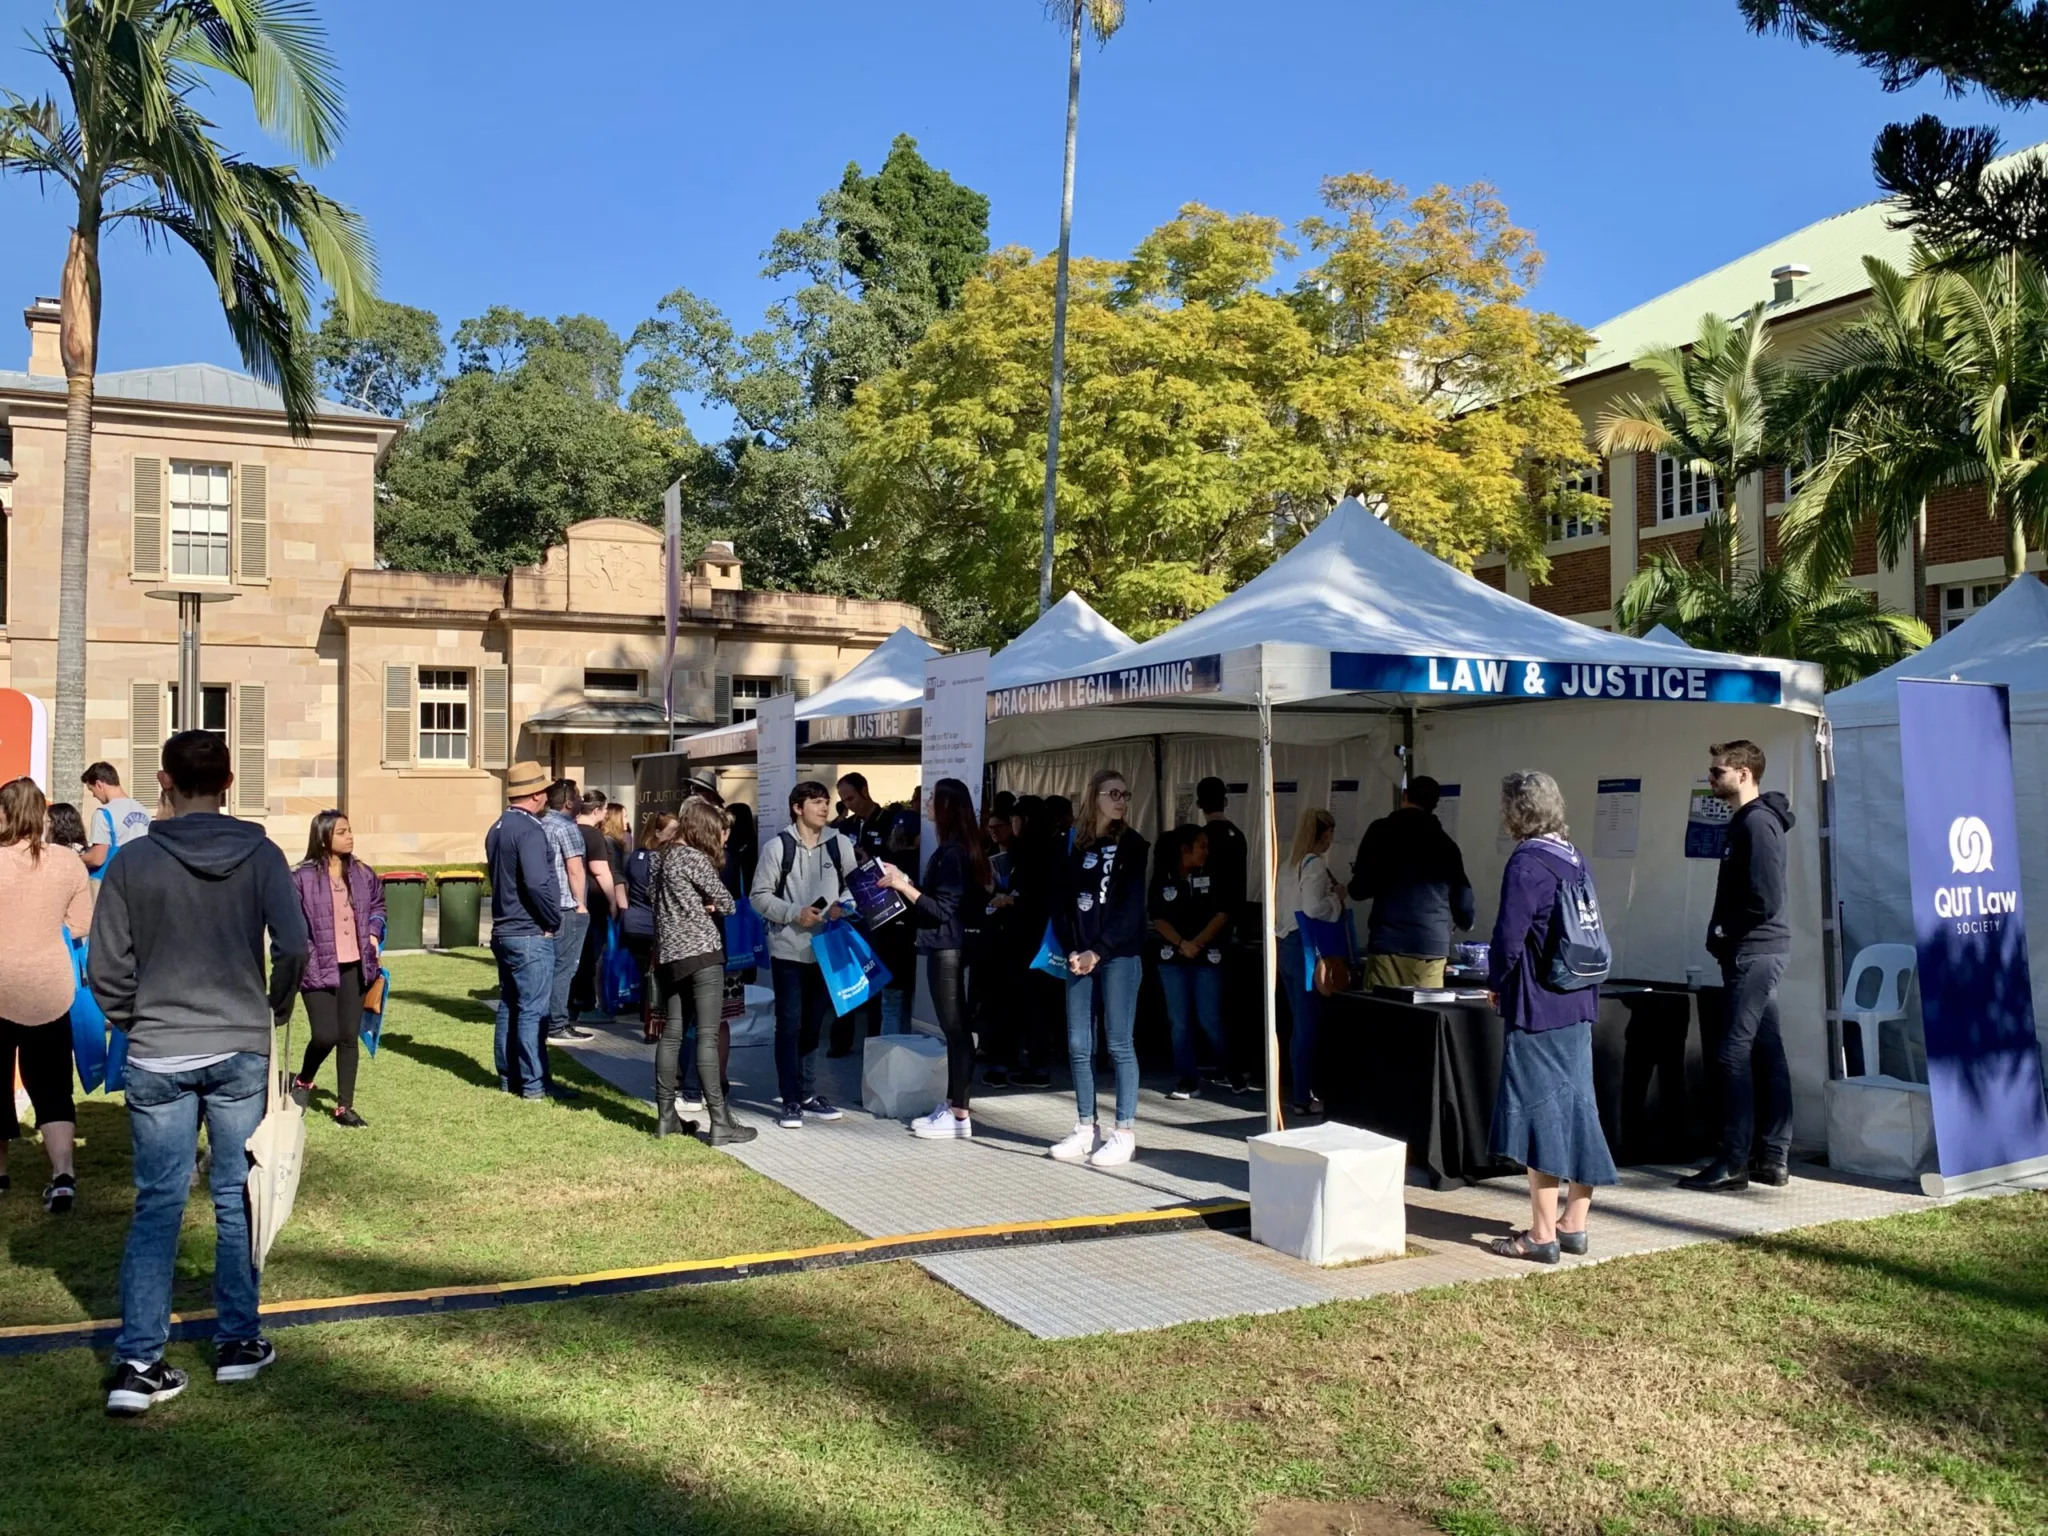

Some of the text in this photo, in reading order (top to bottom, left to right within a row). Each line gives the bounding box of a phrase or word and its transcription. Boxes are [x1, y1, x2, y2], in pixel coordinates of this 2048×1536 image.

[995, 660, 1194, 718] PRACTICAL LEGAL TRAINING
[1428, 657, 1707, 699] LAW & JUSTICE
[819, 711, 899, 741] LAW & JUSTICE
[654, 788, 687, 803] JUSTICE
[1934, 886, 2017, 918] QUT Law
[1956, 920, 2001, 935] SOCIETY
[863, 959, 876, 973] QUT
